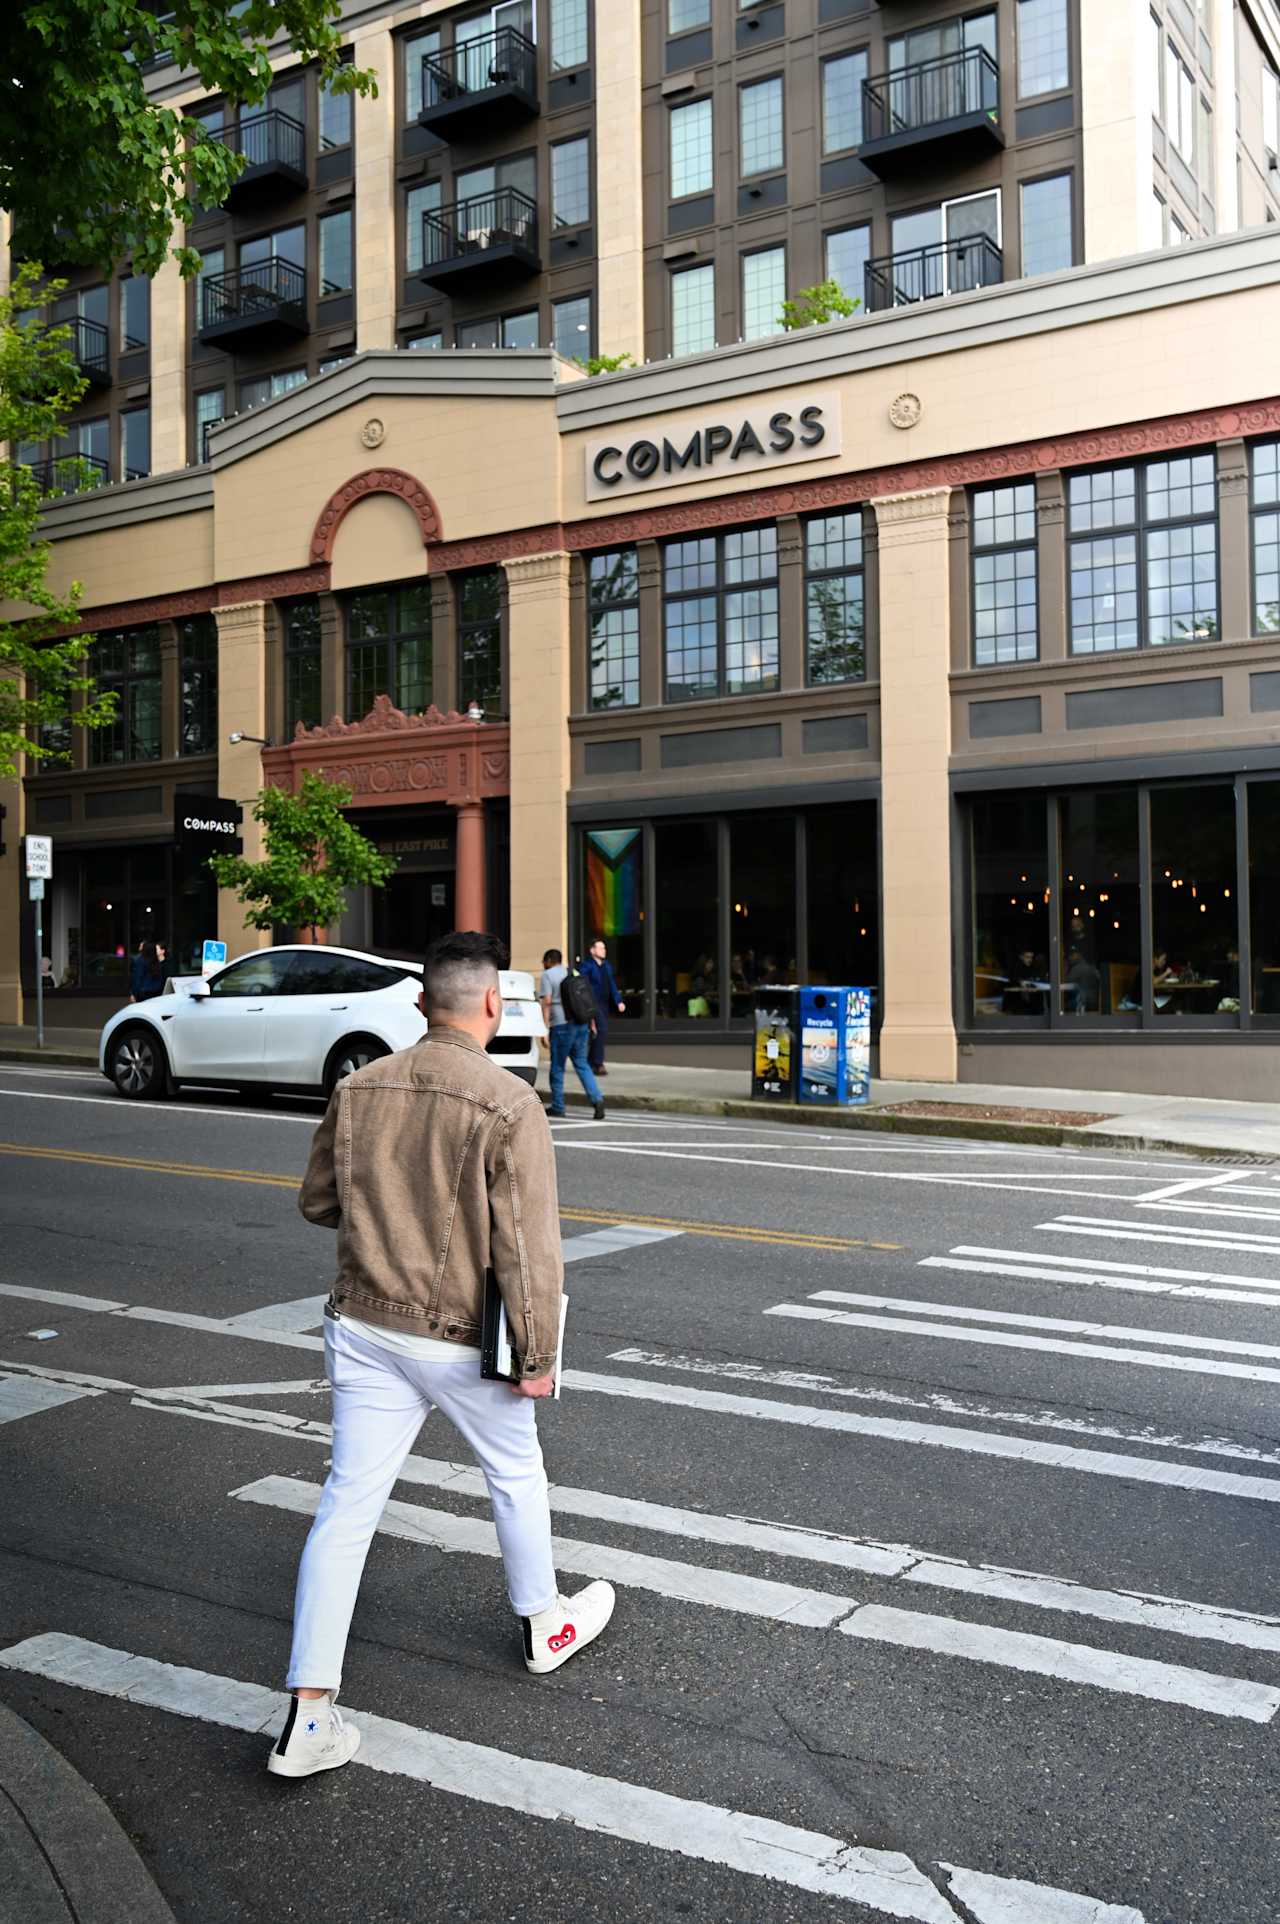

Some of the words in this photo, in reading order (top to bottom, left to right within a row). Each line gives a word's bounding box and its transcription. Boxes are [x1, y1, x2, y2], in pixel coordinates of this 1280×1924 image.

[593, 406, 825, 485] COMPASS
[183, 817, 235, 834] COMPASS
[806, 1018, 834, 1028] Recycle
